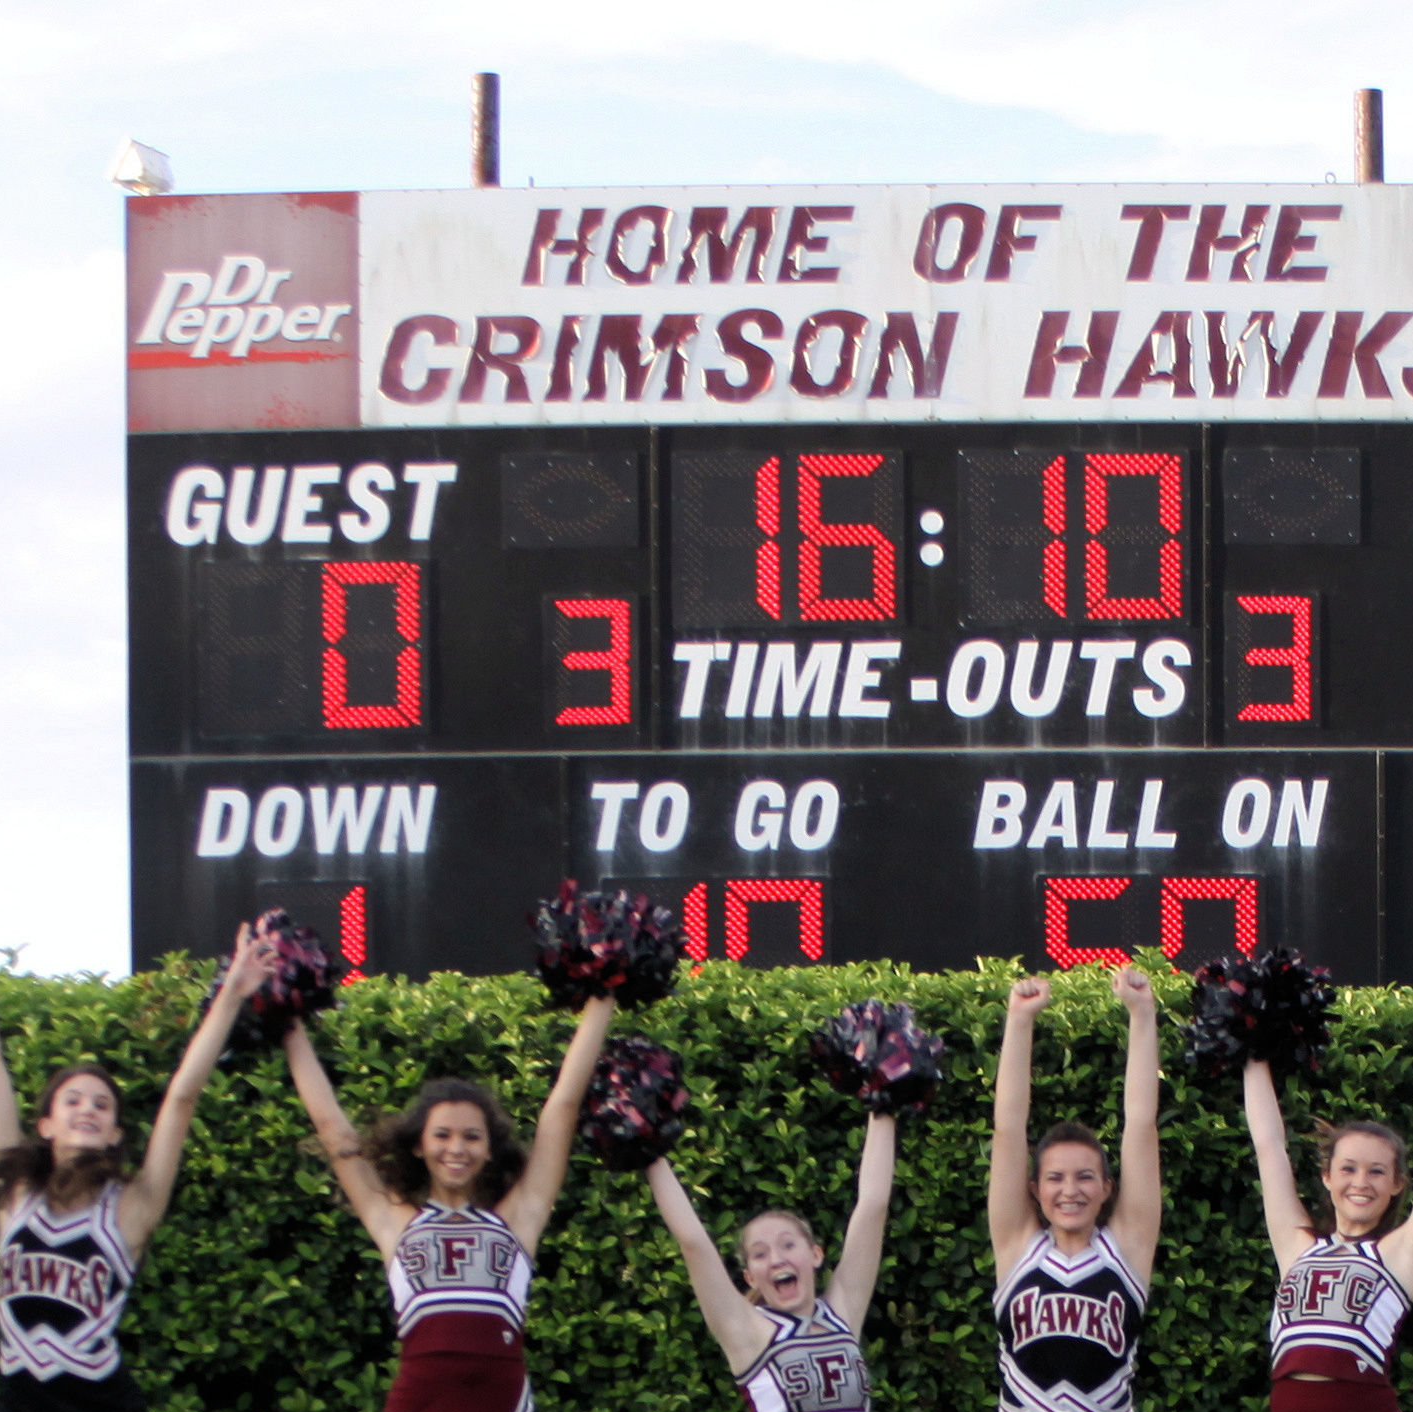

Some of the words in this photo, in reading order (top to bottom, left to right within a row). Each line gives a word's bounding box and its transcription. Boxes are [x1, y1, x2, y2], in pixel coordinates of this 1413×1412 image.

[205, 255, 292, 305] Dr
[522, 205, 854, 287] HOME
[913, 203, 1062, 283] OF
[1120, 203, 1342, 284] THE
[135, 271, 352, 358] Pepper
[378, 307, 957, 404] CRIMSON
[167, 463, 457, 546] GUEST
[322, 561, 421, 728] 0
[555, 598, 631, 726] 3
[672, 639, 1192, 721] TIME-OUTS
[1237, 594, 1311, 721] 3
[197, 785, 437, 857] DOWN
[591, 782, 691, 852] TO
[735, 780, 840, 852] GO
[973, 780, 1178, 850] BALL
[1221, 779, 1329, 850] ON
[399, 1232, 517, 1282] SFC
[1276, 1265, 1378, 1317] SFC
[1009, 1285, 1126, 1358] HAWKS
